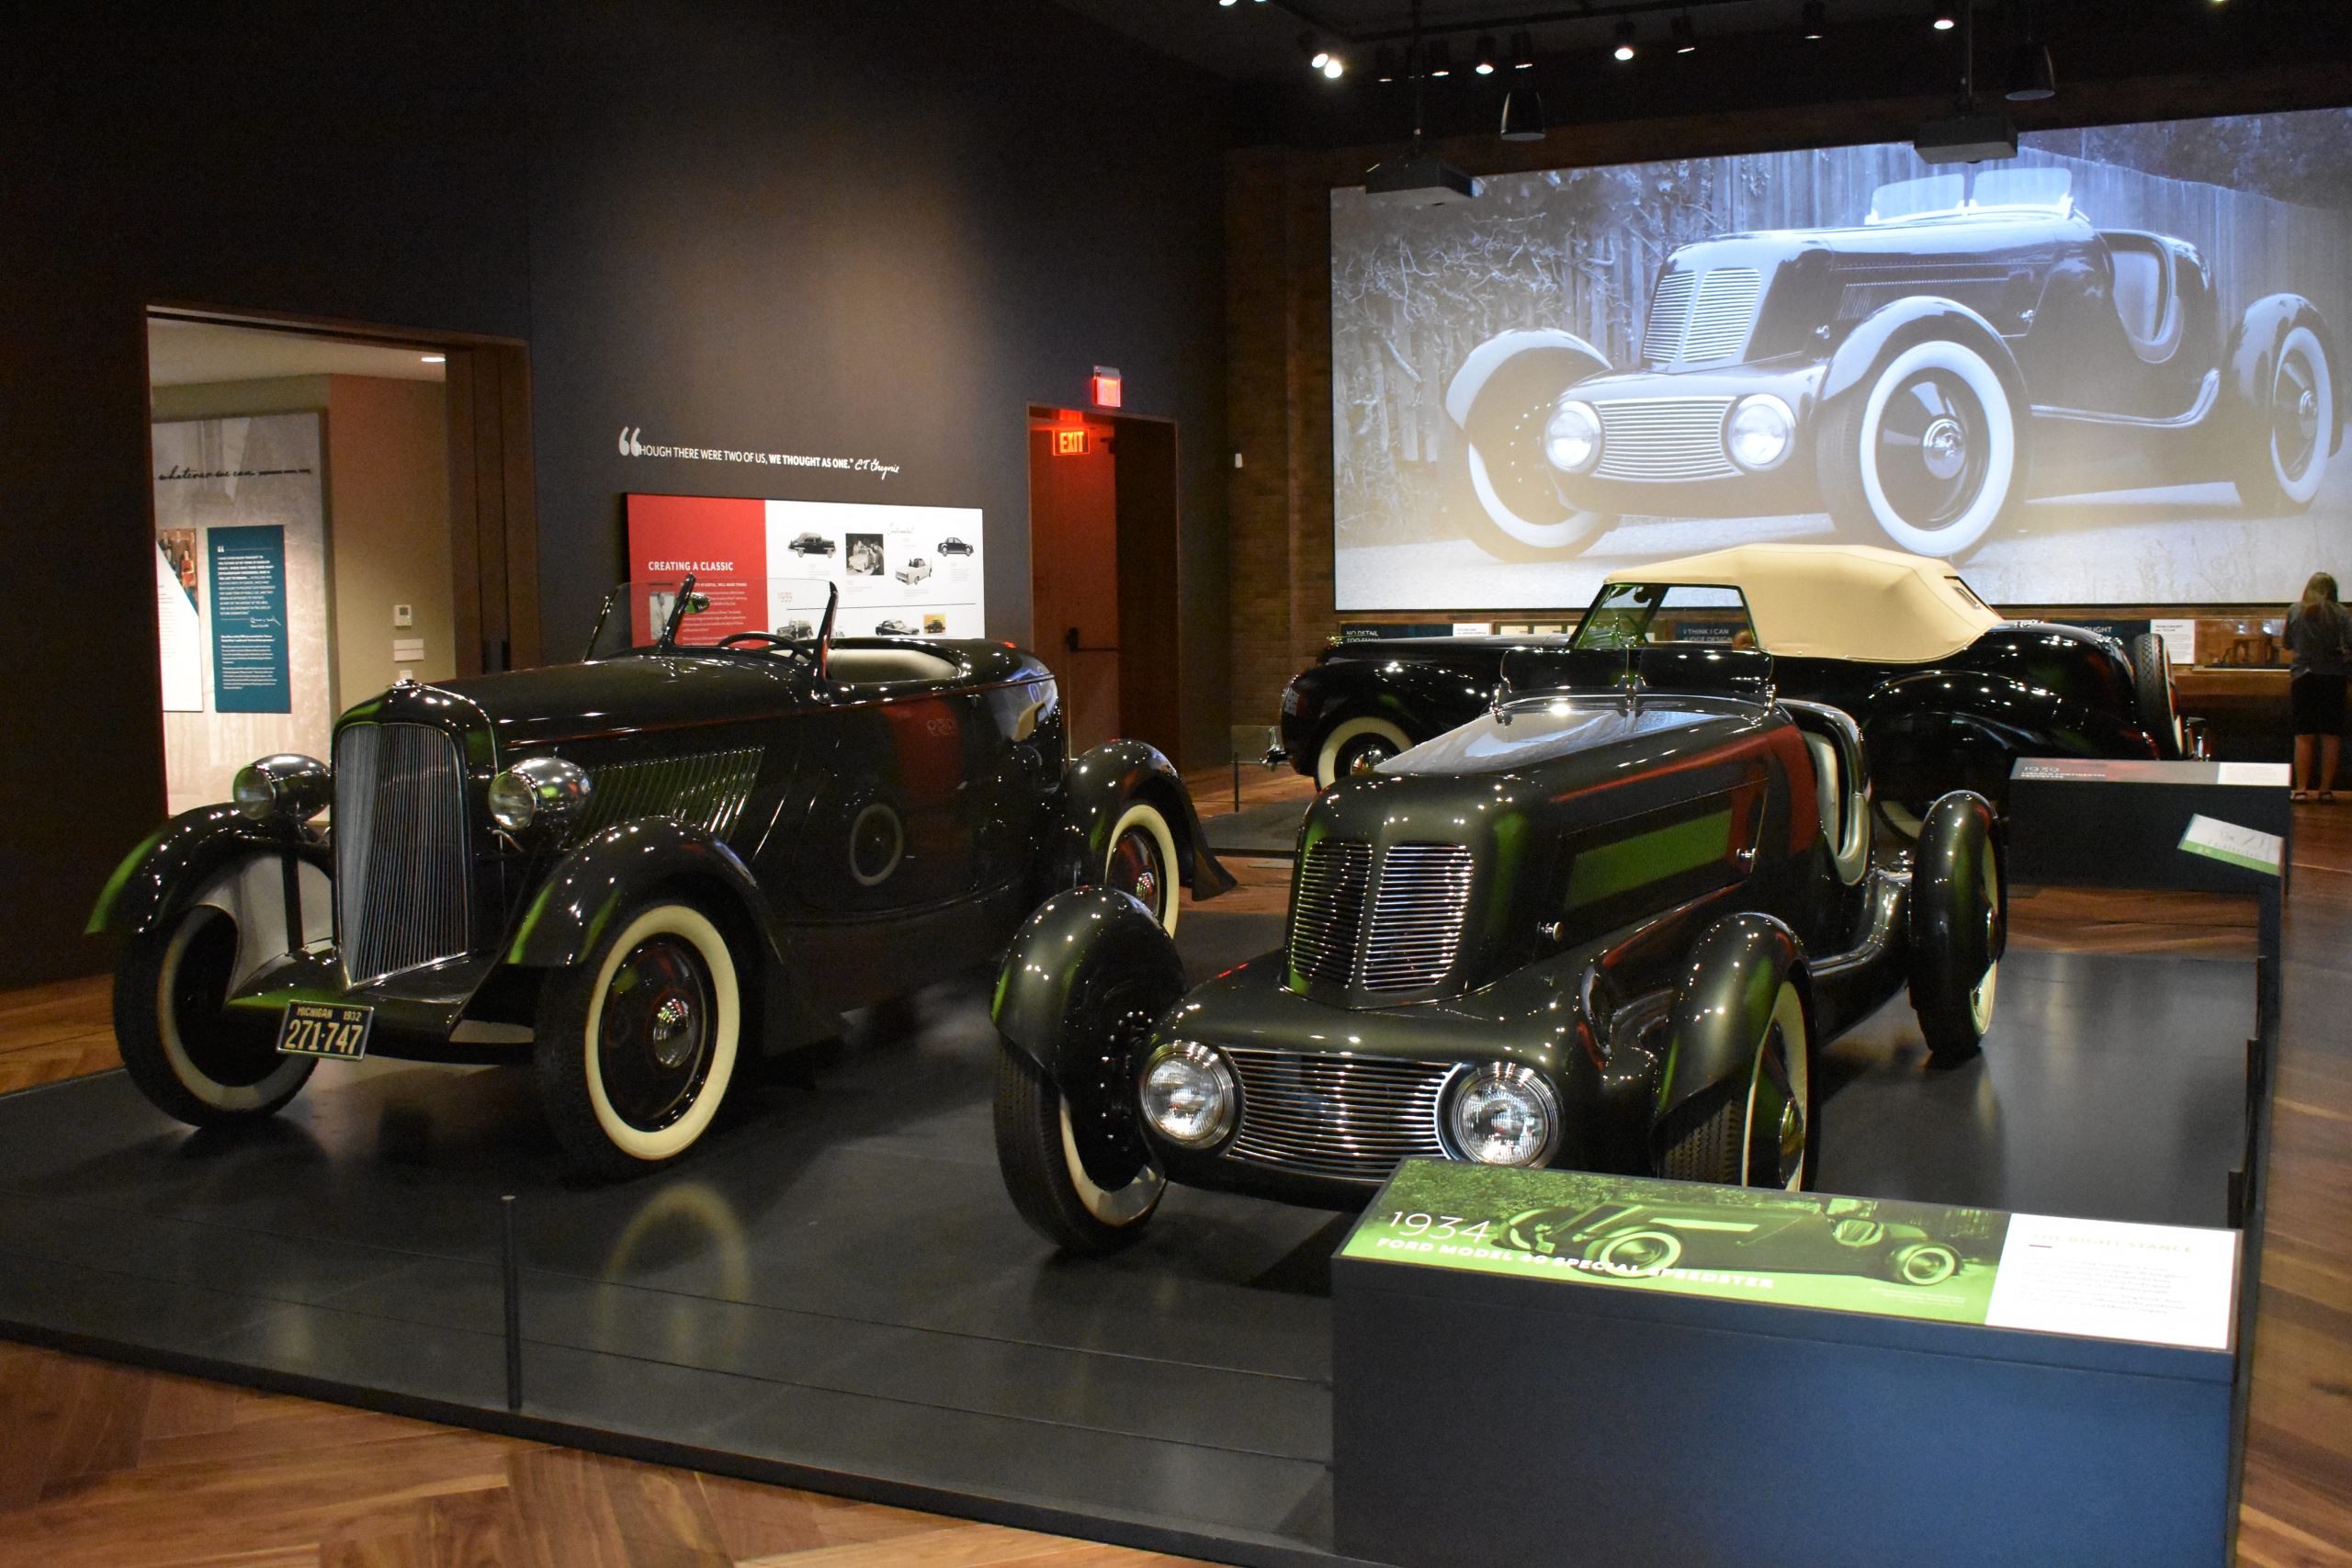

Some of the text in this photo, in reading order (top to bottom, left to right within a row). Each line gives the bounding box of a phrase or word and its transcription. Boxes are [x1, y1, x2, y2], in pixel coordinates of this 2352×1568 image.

[1059, 431, 1084, 454] EXIT
[635, 445, 672, 457] HOUGH
[673, 447, 699, 459] THERE
[700, 449, 722, 461] WERE
[724, 451, 742, 462] TWO
[743, 452, 754, 463] OF
[755, 453, 768, 465] US,
[768, 454, 782, 465] WE
[782, 455, 820, 468] THOUGHT
[821, 457, 831, 468] AS
[648, 561, 734, 571] CREATING A CLASSIC
[297, 1006, 362, 1021] MICHIGAN 1932
[1389, 1211, 1490, 1244] 1934
[1376, 1237, 1774, 1289] FORD MODEL 40 SPECIAL SPEEDSTER
